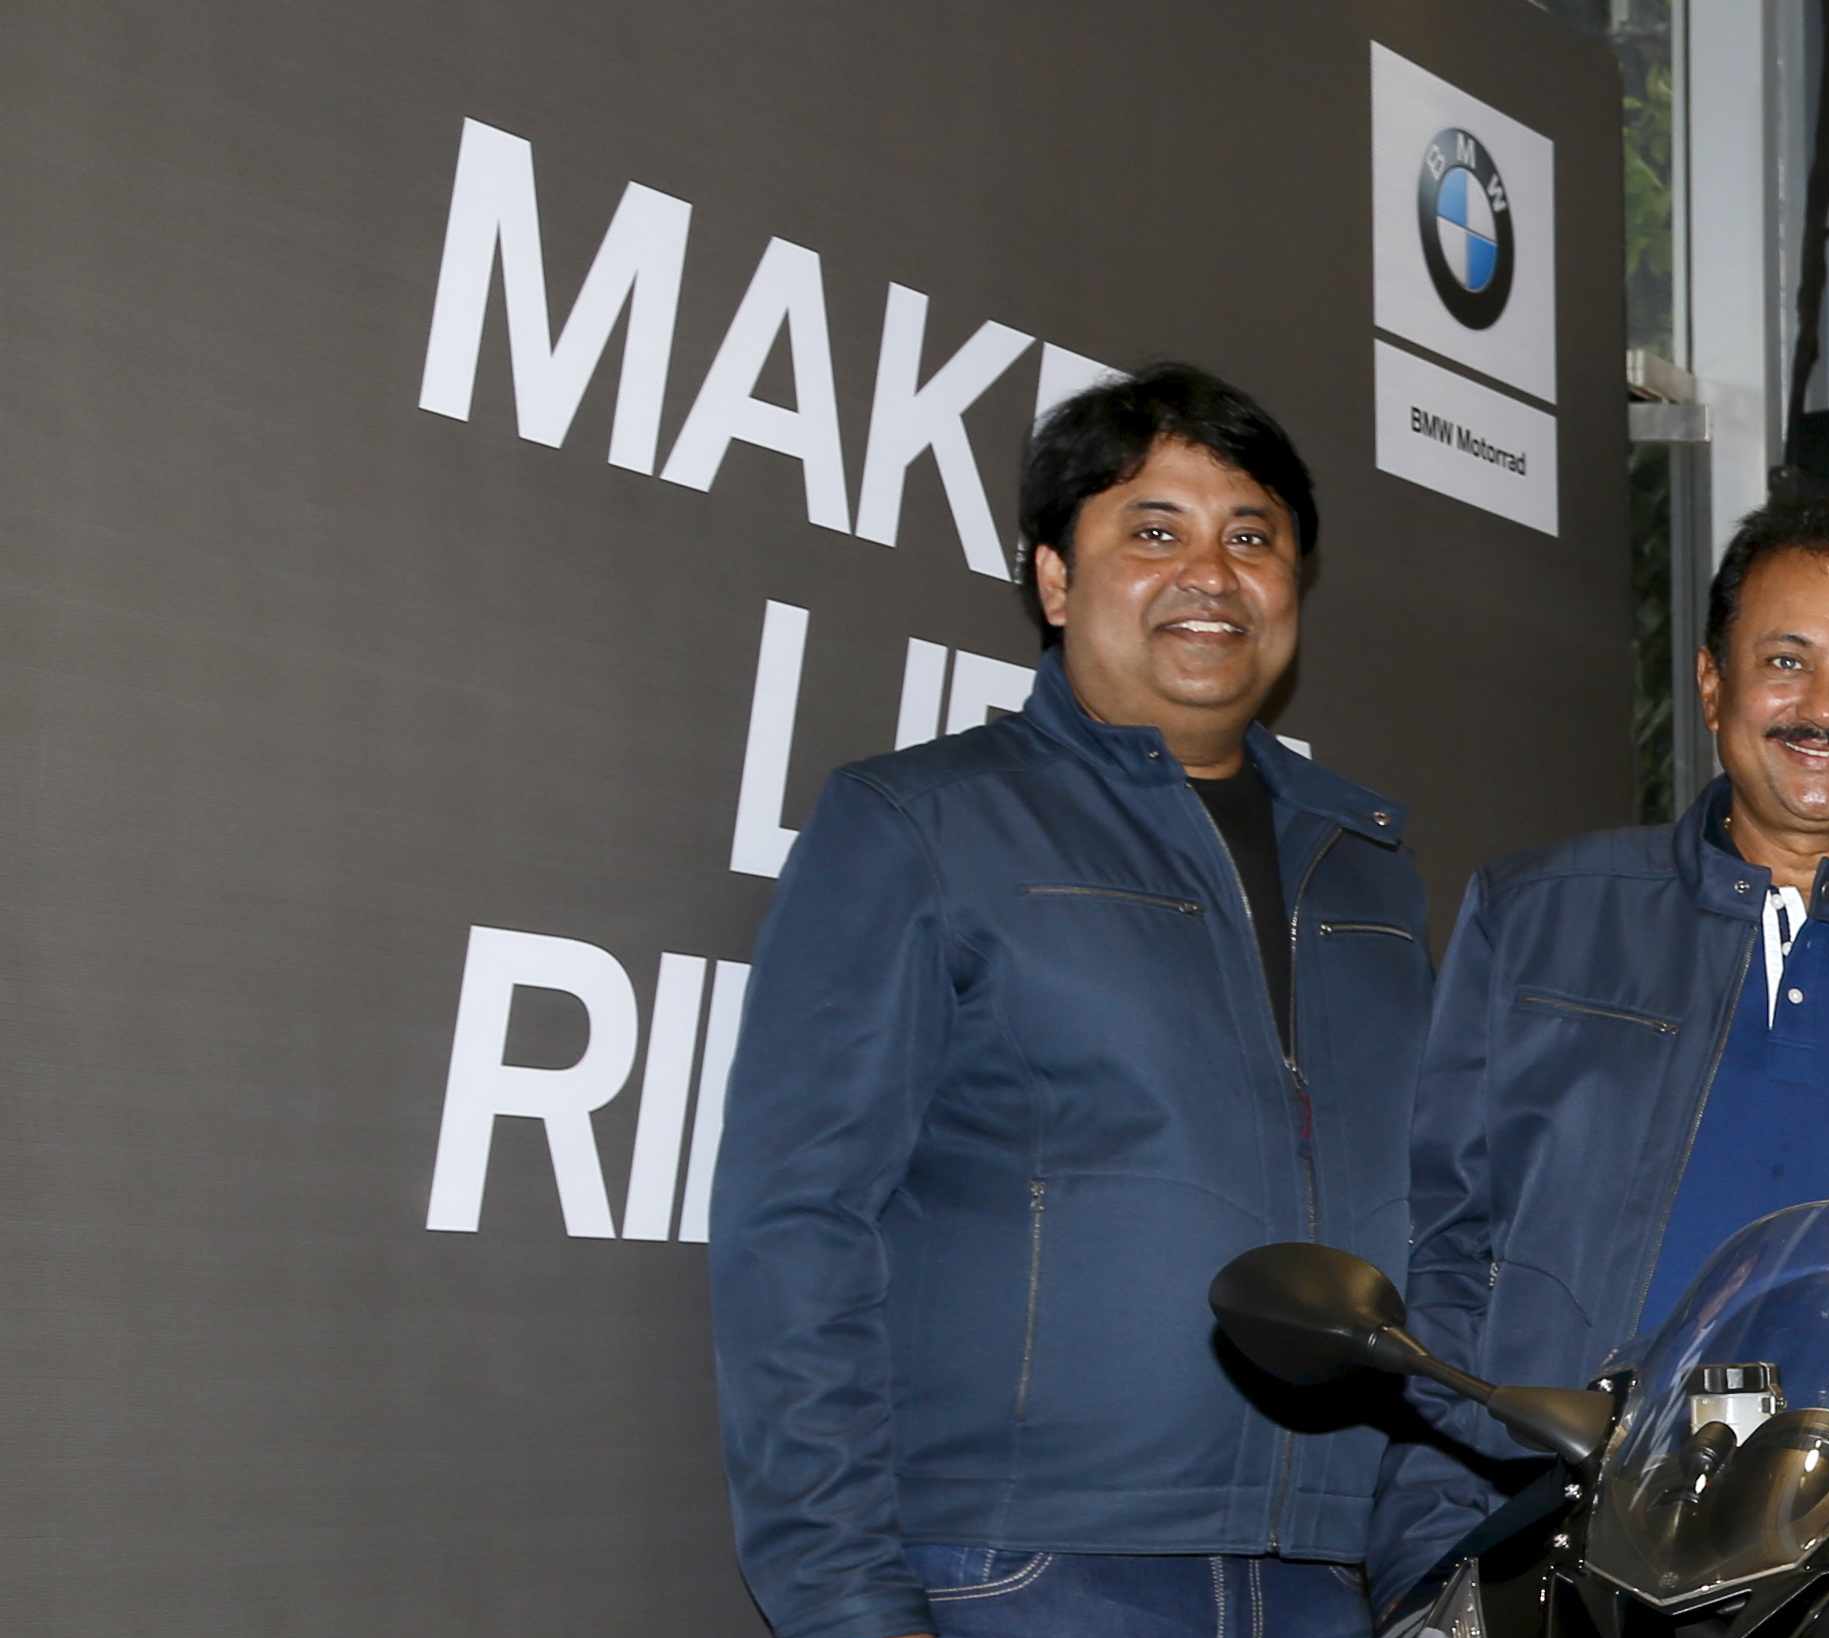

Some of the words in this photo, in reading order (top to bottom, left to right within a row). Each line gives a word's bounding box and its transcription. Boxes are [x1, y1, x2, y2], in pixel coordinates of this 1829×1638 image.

[1425, 133, 1507, 213] BMW
[1411, 405, 1454, 445] BMW
[1456, 425, 1526, 476] Motorrad
[426, 925, 752, 1243] RI
